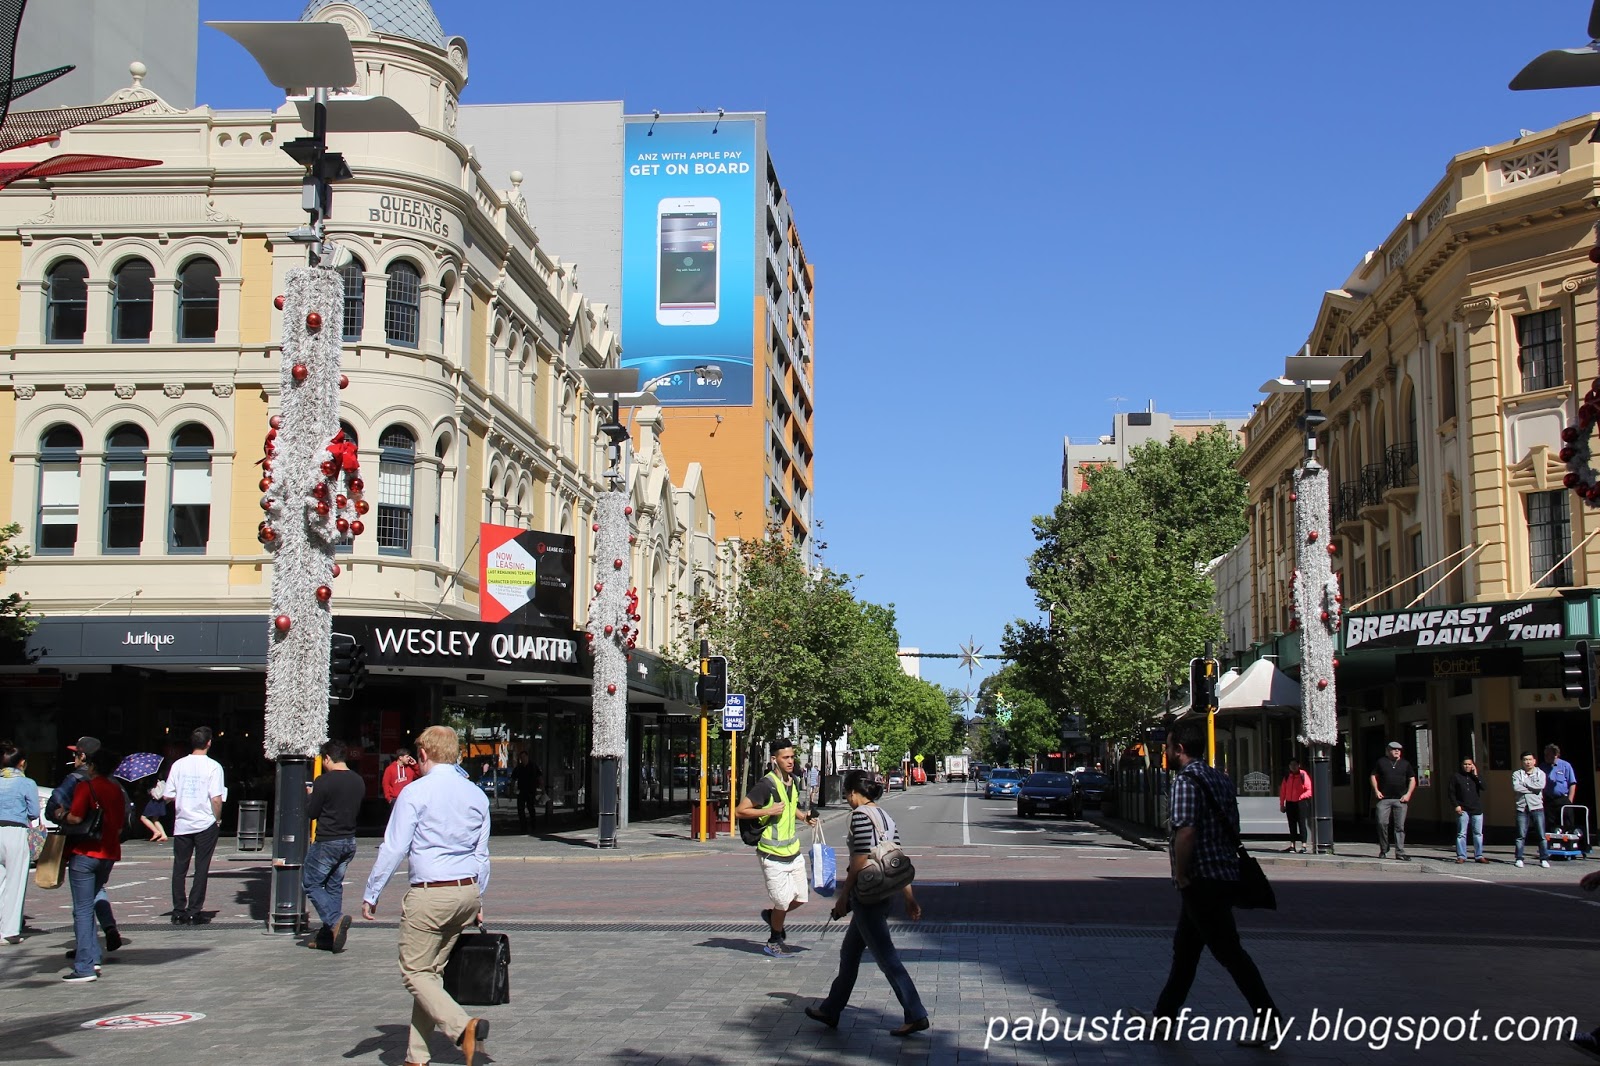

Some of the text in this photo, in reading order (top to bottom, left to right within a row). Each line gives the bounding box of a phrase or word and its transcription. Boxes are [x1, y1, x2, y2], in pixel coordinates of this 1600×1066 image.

[638, 151, 742, 161] ANZ WITH APPLE PAY
[630, 162, 750, 176] GET ON BOARD
[380, 195, 442, 222] QUEEN'S
[368, 208, 449, 238] BUILDINGS
[495, 552, 513, 561] NOW
[495, 560, 526, 571] LEASING
[1346, 603, 1533, 649] BREAKFAST FROM
[1417, 623, 1562, 646] DAILY 7am
[121, 631, 175, 652] Jurlique
[375, 628, 578, 665] WESLEY QUARTER
